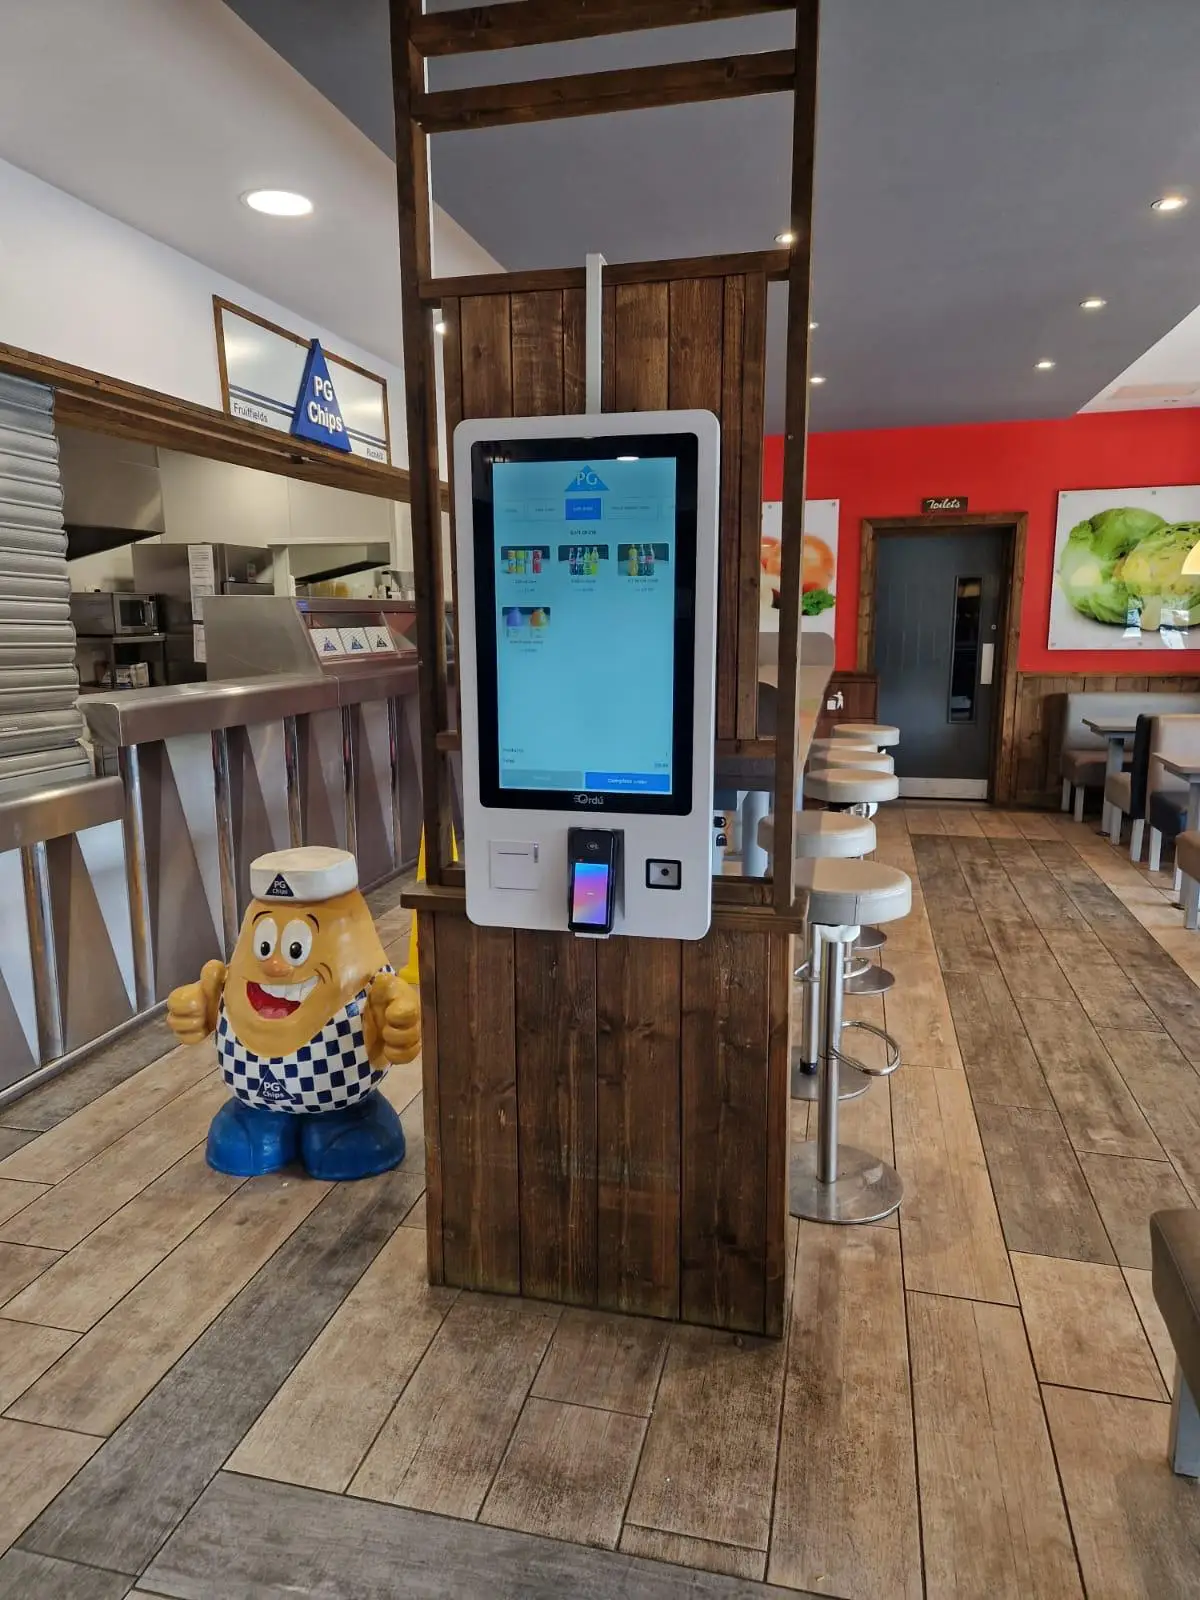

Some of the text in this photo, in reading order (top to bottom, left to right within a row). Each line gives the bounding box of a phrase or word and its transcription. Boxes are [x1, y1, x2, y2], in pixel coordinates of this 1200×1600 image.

[313, 376, 334, 401] PG
[233, 402, 269, 423] Fruitfields
[307, 401, 344, 433] Chips
[576, 471, 599, 486] PG
[927, 498, 961, 509] Toilets
[273, 880, 287, 889] PG
[263, 1081, 281, 1092] PG
[262, 1090, 285, 1099] Chips
